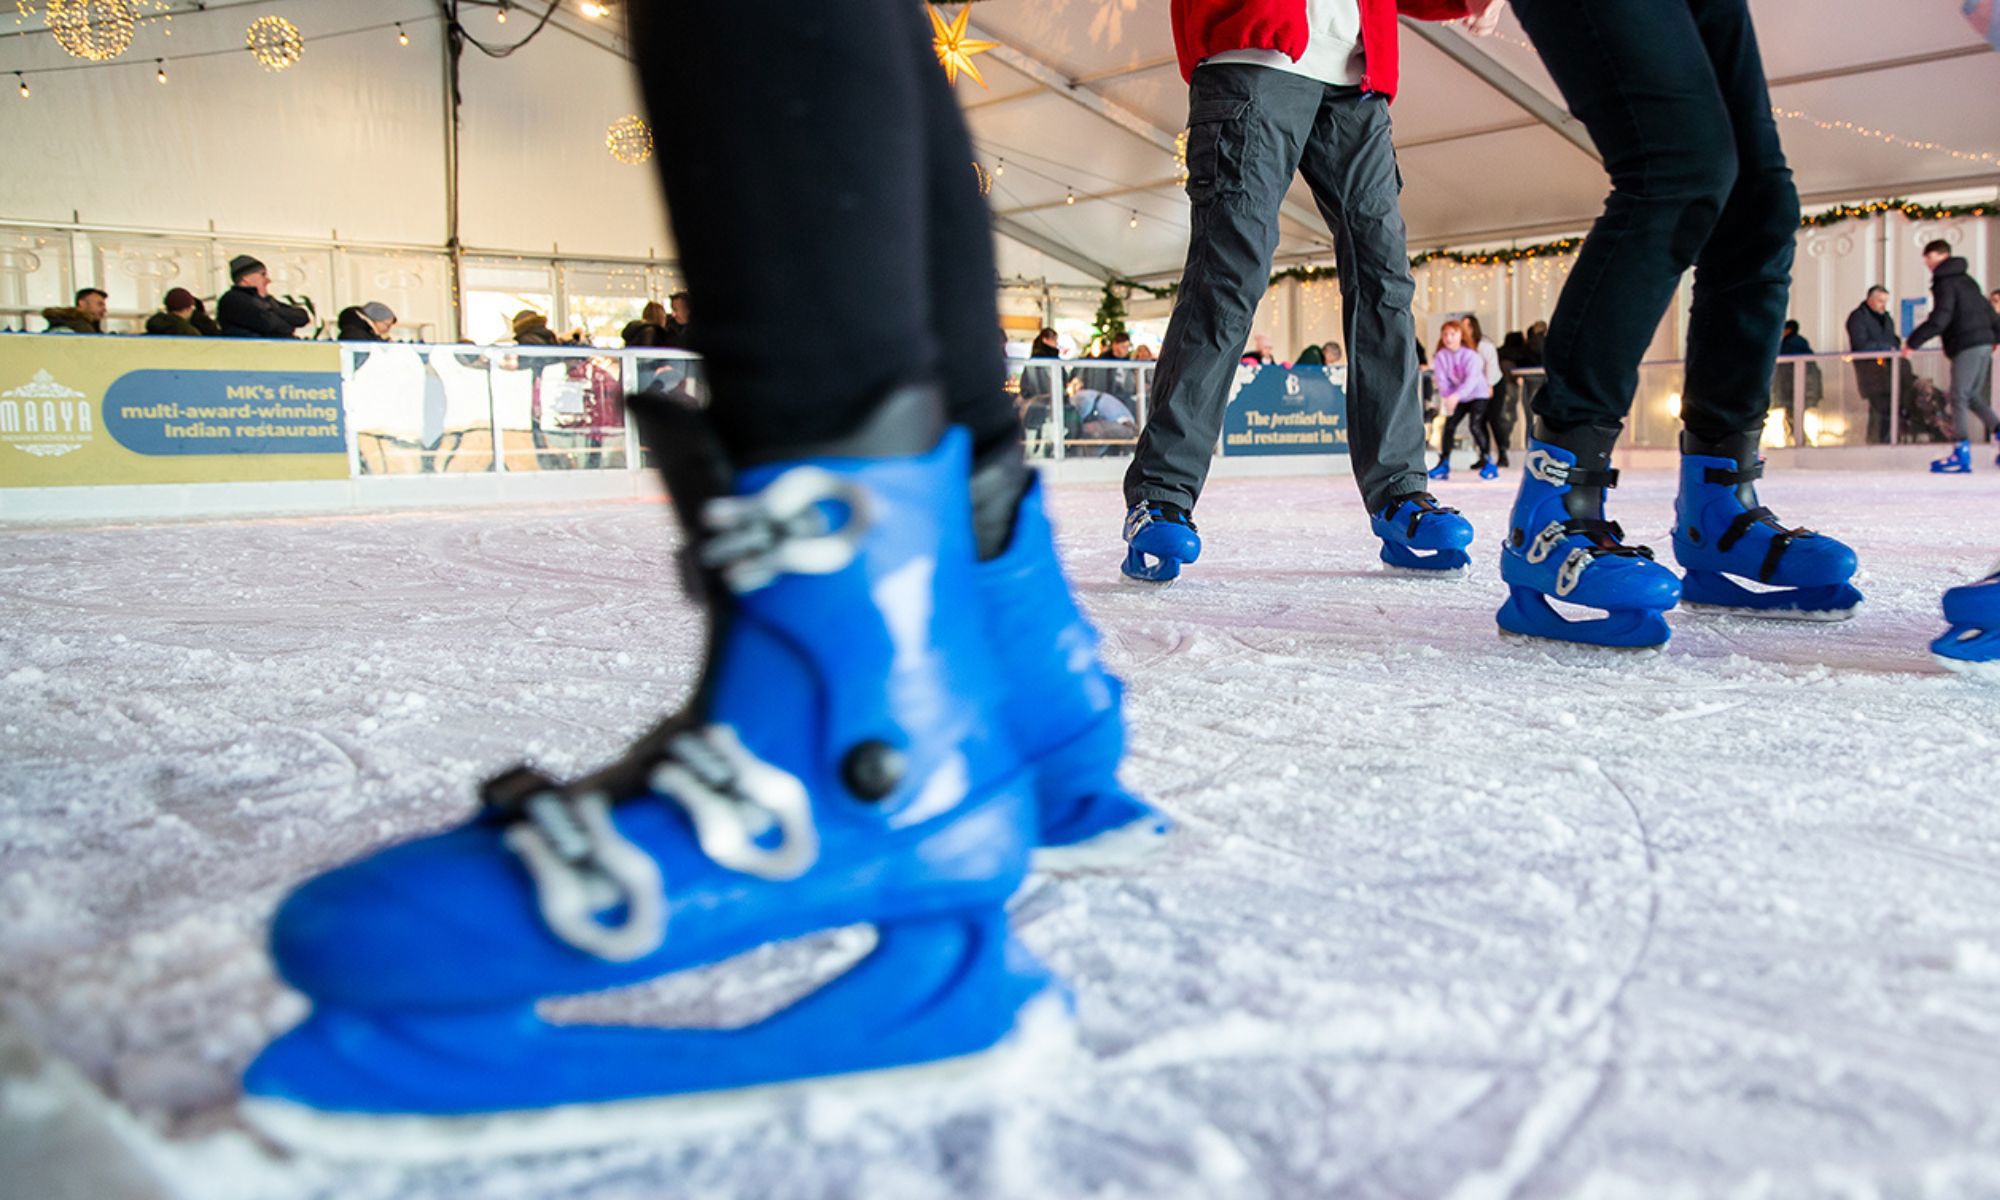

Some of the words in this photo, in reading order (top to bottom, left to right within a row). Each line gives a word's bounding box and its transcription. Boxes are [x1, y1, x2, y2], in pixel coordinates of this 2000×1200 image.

[226, 385, 275, 400] MK's
[279, 385, 337, 400] finest
[0, 400, 92, 432] MAAYA
[121, 403, 338, 421] multi-award-winning
[1246, 411, 1269, 425] The
[1317, 411, 1339, 425] bar
[164, 423, 231, 438] Indian
[235, 423, 339, 438] restaurant
[1227, 429, 1252, 444] and
[1254, 431, 1319, 444] restaurant
[1321, 429, 1333, 443] in
